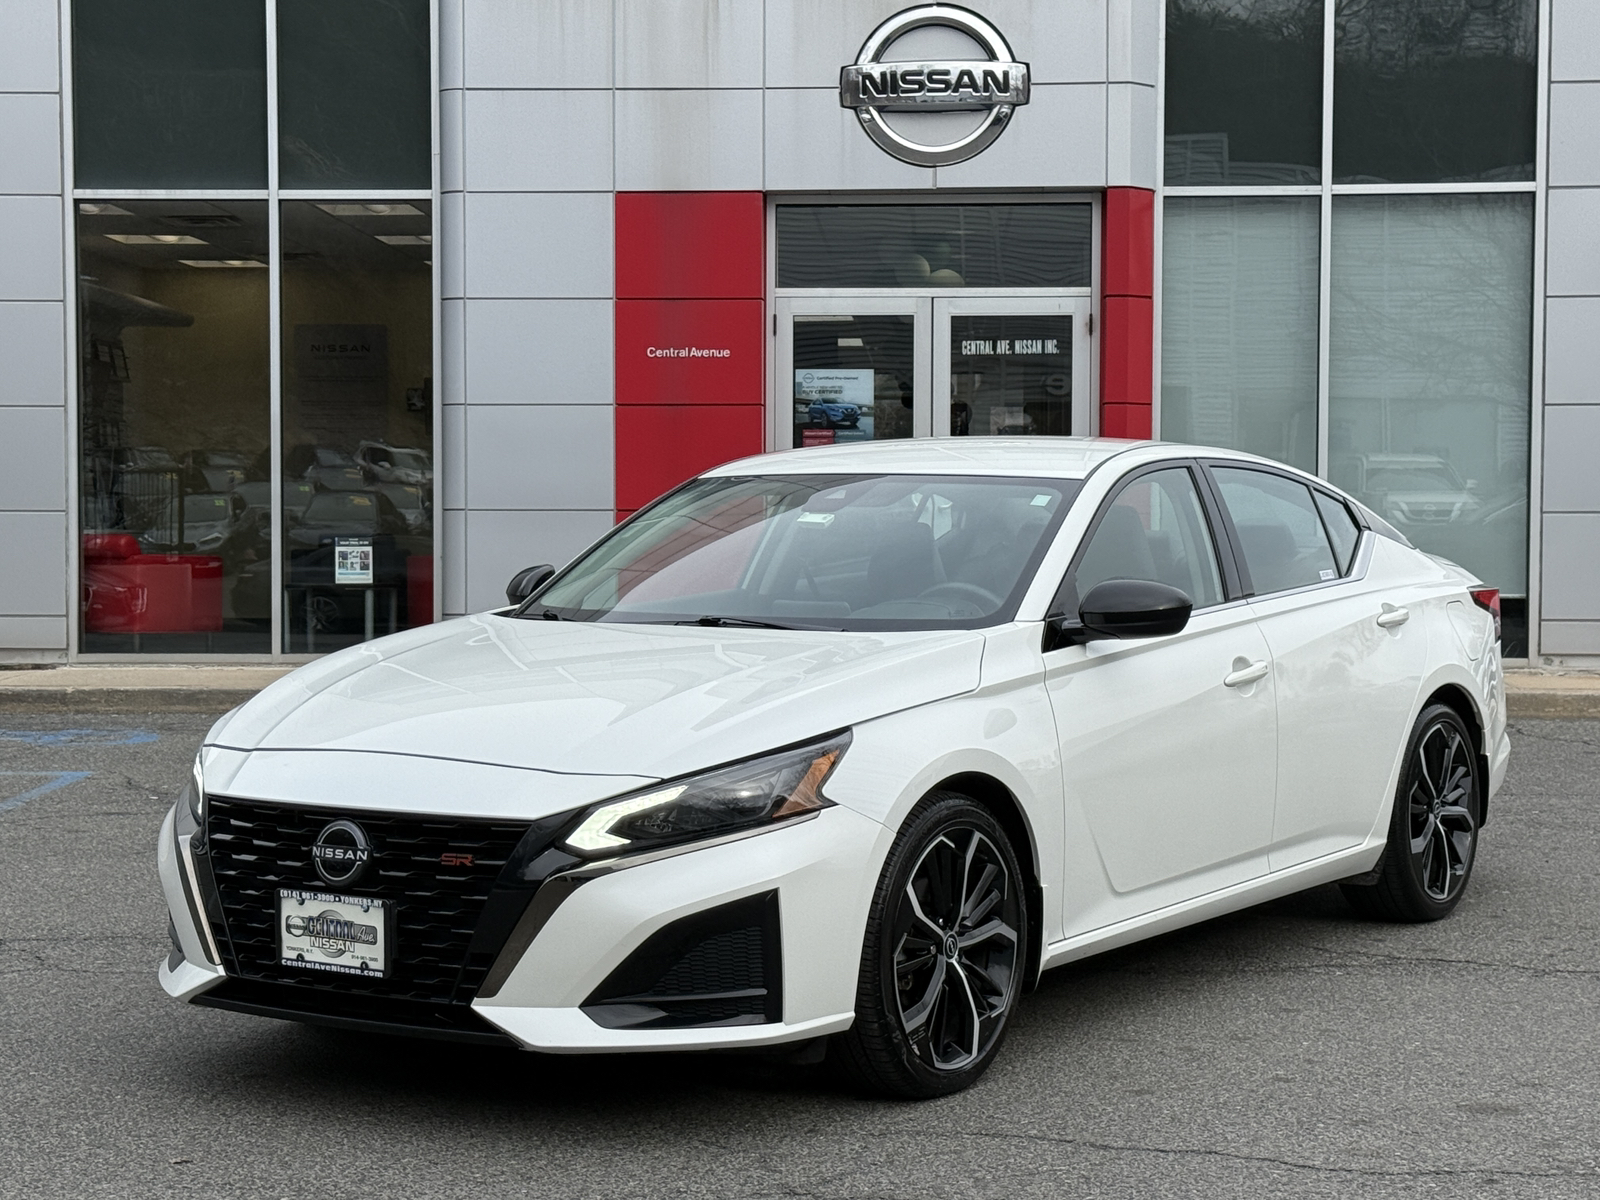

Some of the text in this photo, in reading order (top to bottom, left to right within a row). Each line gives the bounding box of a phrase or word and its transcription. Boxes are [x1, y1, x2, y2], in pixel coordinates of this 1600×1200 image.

[860, 69, 1010, 98] NISSAN
[310, 344, 371, 353] NISSAN
[646, 346, 731, 358] Central Avenue
[961, 339, 1060, 355] CENTRAL AVE. NISSAN INC.
[312, 846, 368, 861] NISSAN
[440, 853, 474, 867] SR
[307, 916, 356, 940] CENTRAL
[310, 936, 355, 953] NISSAN
